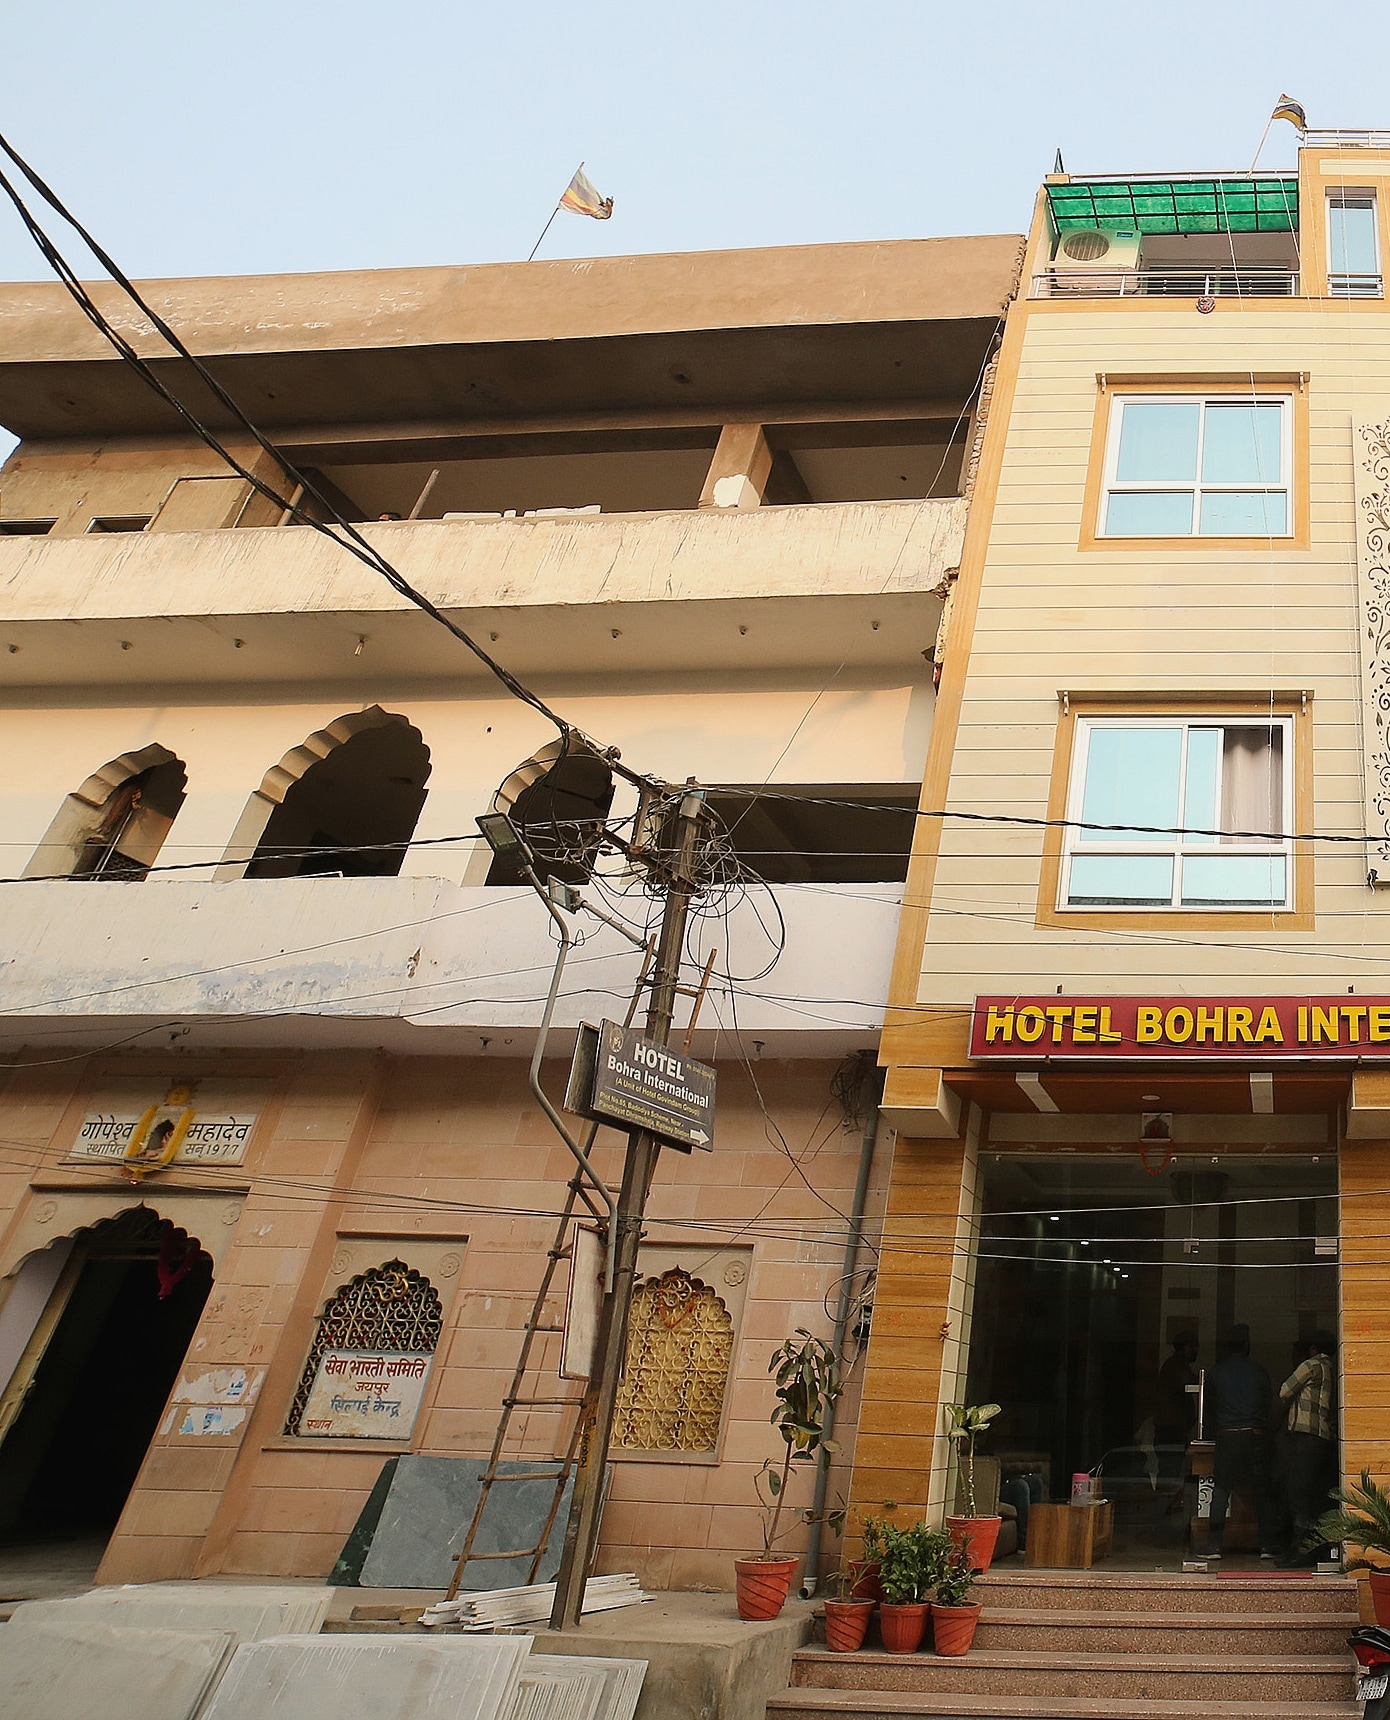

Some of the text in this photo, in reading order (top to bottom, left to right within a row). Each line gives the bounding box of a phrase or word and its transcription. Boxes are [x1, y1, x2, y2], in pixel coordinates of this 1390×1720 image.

[985, 1005, 1122, 1043] HOTEL
[1136, 1005, 1284, 1043] BOHRA
[633, 1042, 685, 1082] HOTEL
[607, 1054, 641, 1081] Bohra
[644, 1070, 709, 1109] International
[81, 1115, 251, 1142] गोपेश्व महादेव
[86, 1141, 126, 1156] स्थापित
[325, 1354, 427, 1379] सेवा भारती समिति
[354, 1381, 390, 1395] जयपुर
